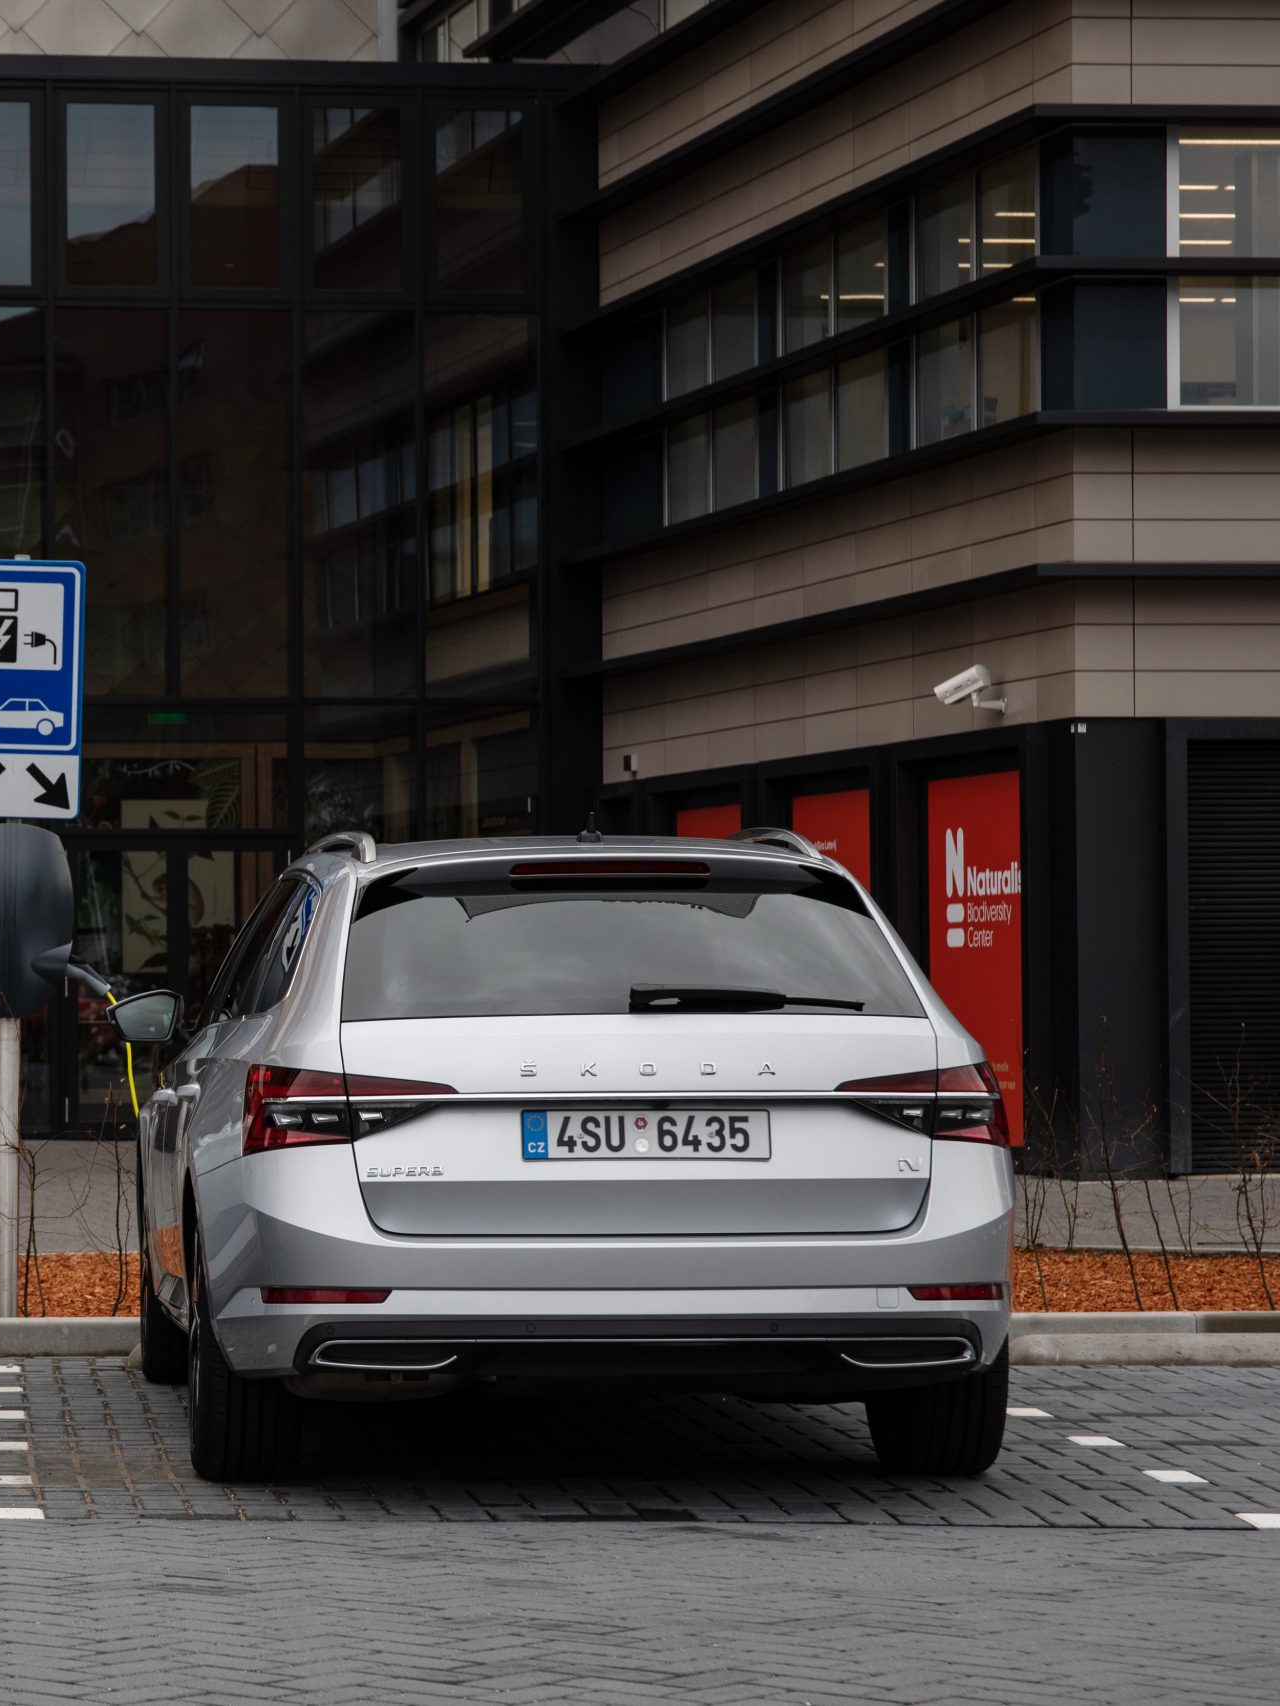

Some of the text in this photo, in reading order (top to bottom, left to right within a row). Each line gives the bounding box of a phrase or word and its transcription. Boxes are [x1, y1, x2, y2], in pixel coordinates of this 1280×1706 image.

[967, 900, 1012, 926] Biodiversity
[967, 926, 993, 947] Center
[520, 1059, 776, 1077] ŠKODA
[527, 1115, 750, 1153] CZ 4SU 6435
[366, 1165, 445, 1178] SUPERB
